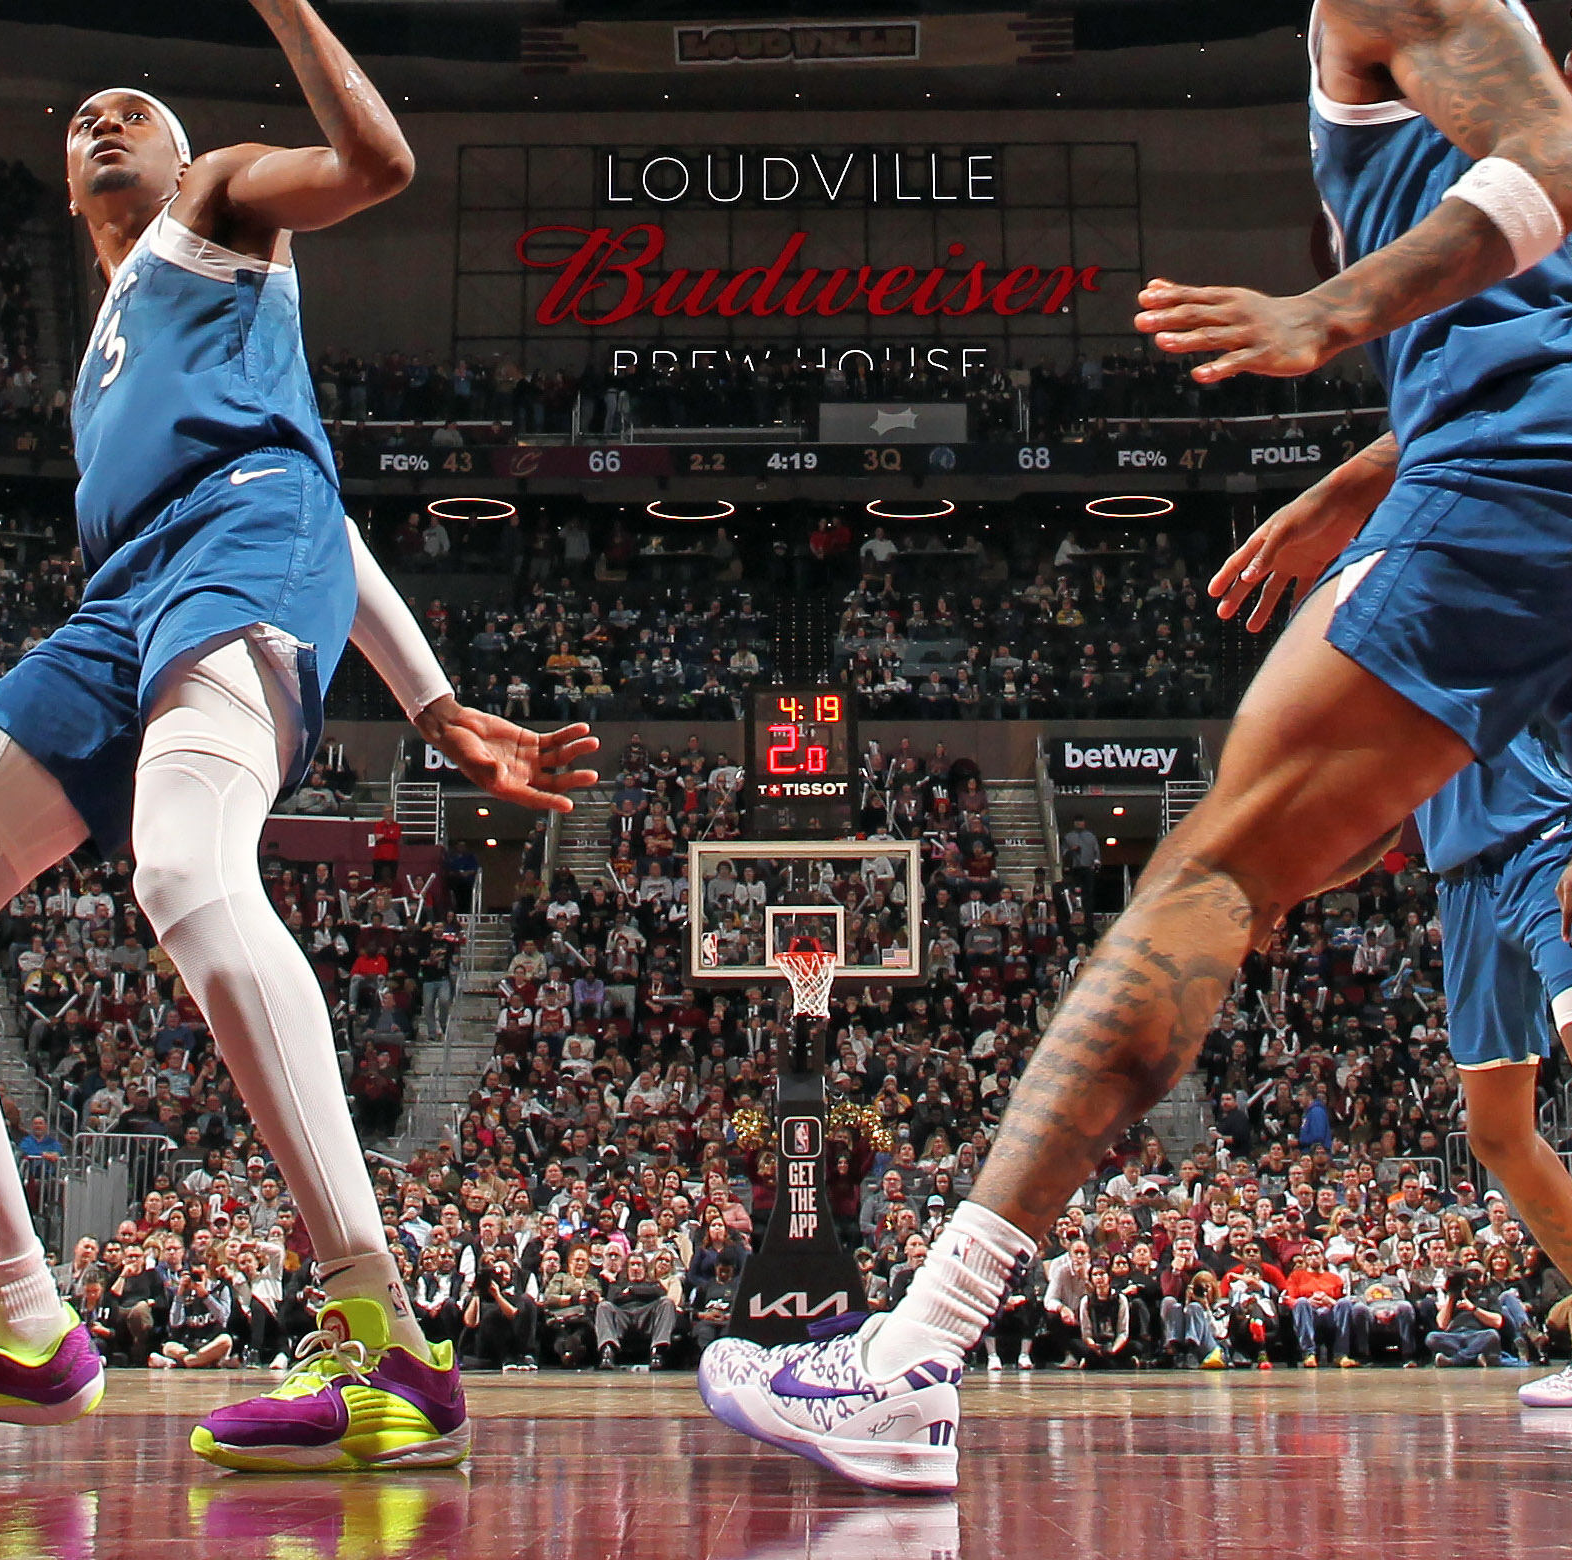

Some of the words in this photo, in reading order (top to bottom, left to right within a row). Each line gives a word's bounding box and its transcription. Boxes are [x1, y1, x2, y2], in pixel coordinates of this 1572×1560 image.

[608, 153, 995, 202] LOUDVILLE
[516, 223, 1103, 326] Budweiser
[380, 453, 429, 472] FG%
[443, 453, 473, 472] 43
[589, 450, 620, 472] 66
[690, 453, 725, 471] 2.2
[767, 452, 817, 470] 4:19
[863, 449, 902, 471] 3Q
[1018, 447, 1050, 469] 68
[1118, 449, 1167, 468] FG%
[1179, 449, 1208, 469] 47
[1251, 444, 1321, 465] FOULS
[778, 694, 842, 722] 4:19
[767, 725, 827, 774] 2.0
[1064, 742, 1178, 775] betway
[781, 782, 848, 796] TISSOT
[788, 1161, 817, 1186] GET
[788, 1187, 818, 1213] THE
[788, 1213, 819, 1239] APP
